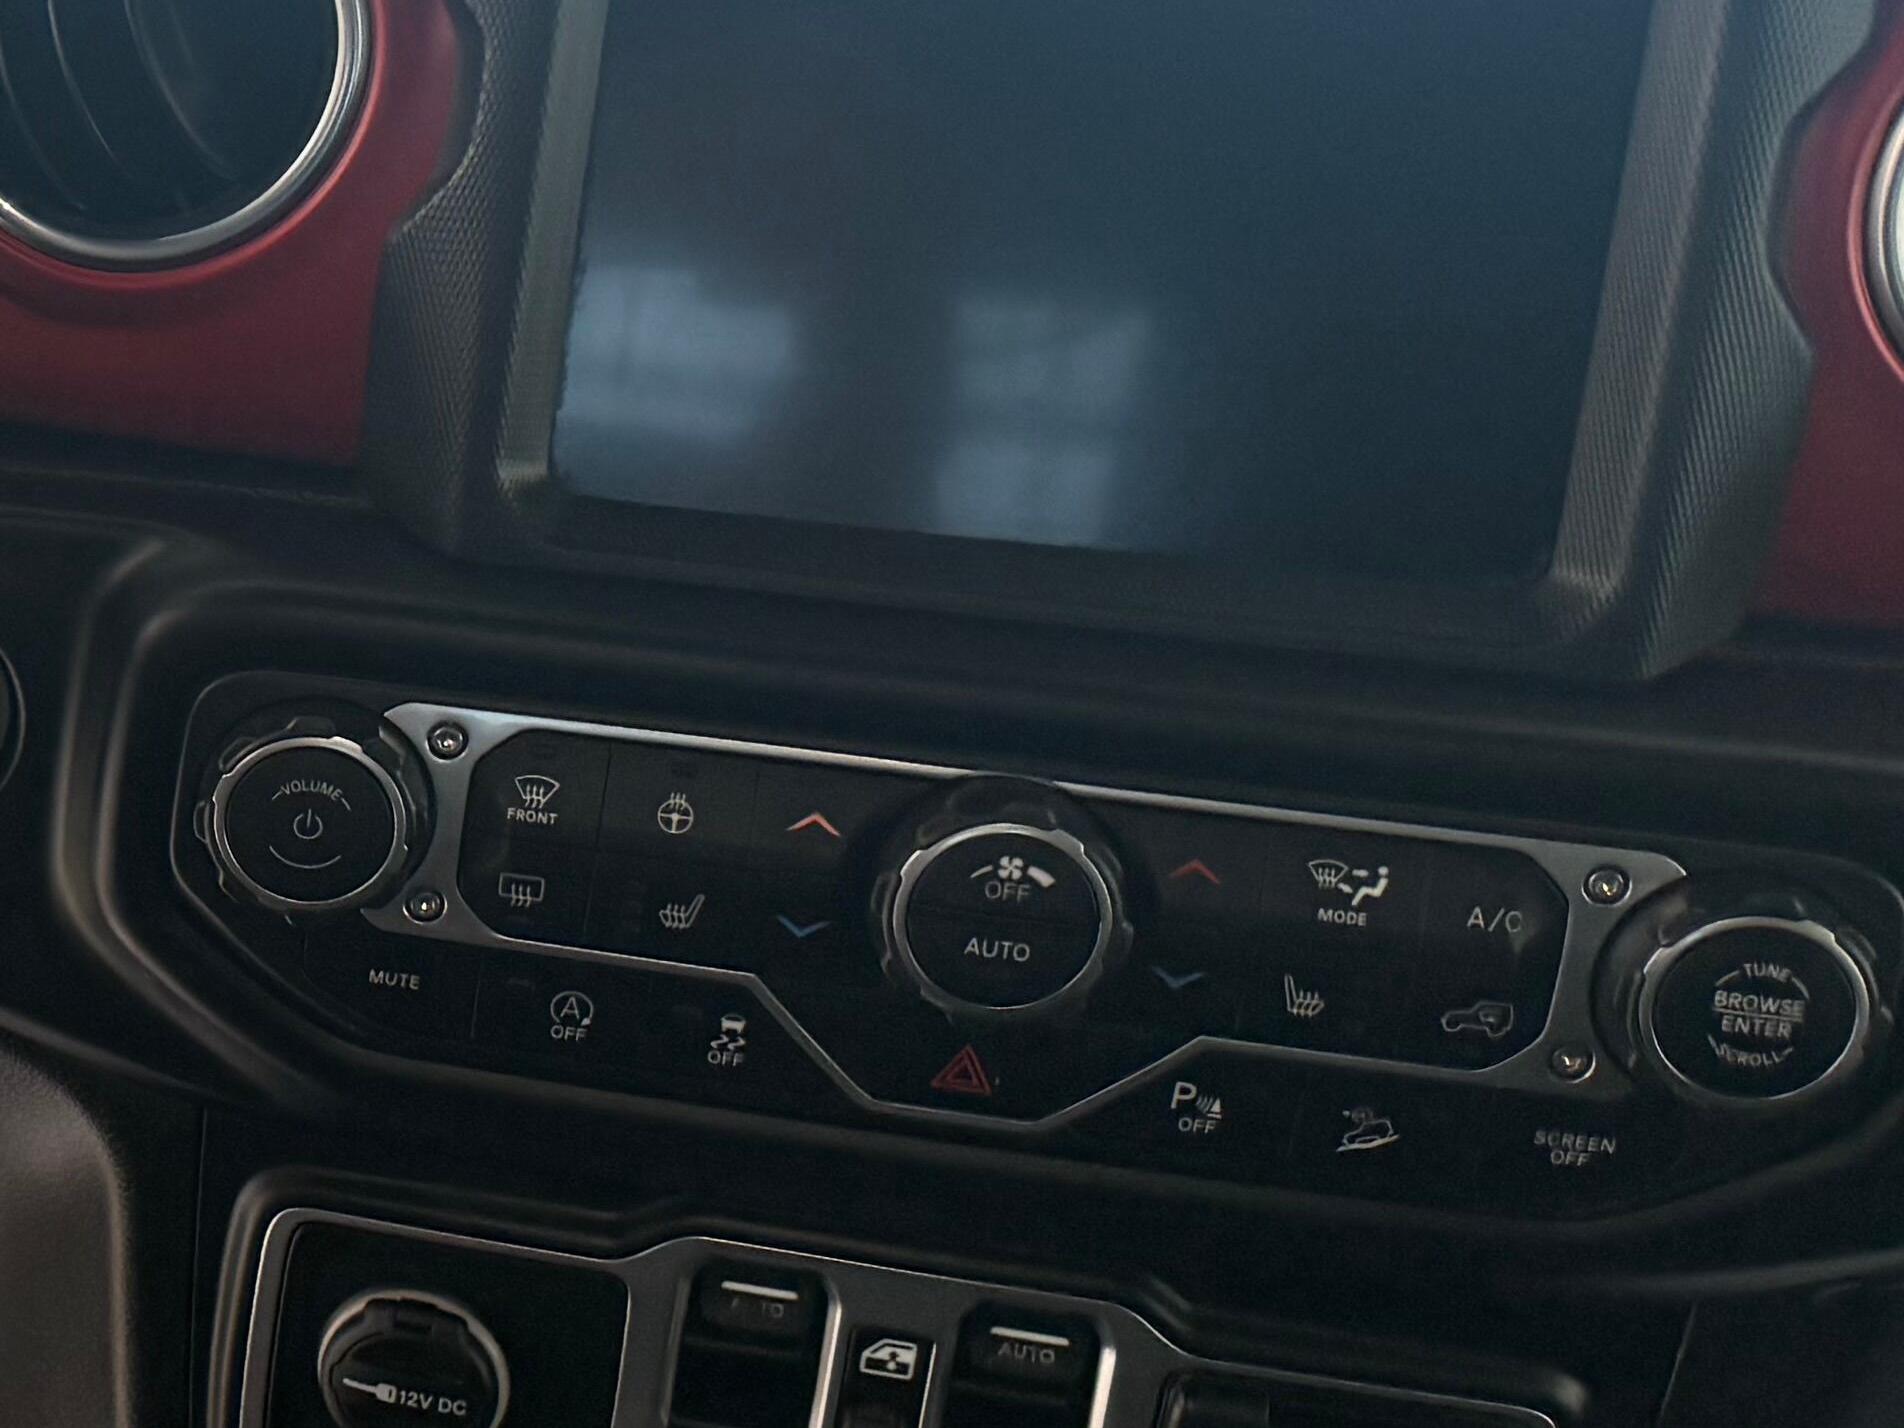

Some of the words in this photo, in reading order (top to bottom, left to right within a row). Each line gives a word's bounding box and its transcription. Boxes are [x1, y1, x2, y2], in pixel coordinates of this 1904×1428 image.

[280, 778, 344, 802] VOLUME
[505, 806, 560, 827] FRONT
[984, 878, 1032, 903] OFF
[1316, 906, 1369, 928] MODE
[1465, 904, 1526, 937] A/C
[963, 935, 1032, 964] AUTO
[367, 968, 421, 991] MUTE
[1743, 962, 1792, 984] TUNE
[1713, 989, 1807, 1018] BROWSE
[549, 1022, 589, 1043] OFF
[1720, 1014, 1792, 1039] ENTER
[706, 1048, 746, 1069] OFF
[1717, 1043, 1783, 1067] SCROLL
[1177, 1116, 1218, 1135] OFF
[1533, 1128, 1617, 1155] SCREEN
[1549, 1148, 1590, 1167] OFF
[998, 1342, 1057, 1365] AUTO
[397, 1388, 433, 1411] 12V
[437, 1396, 467, 1417] DC
